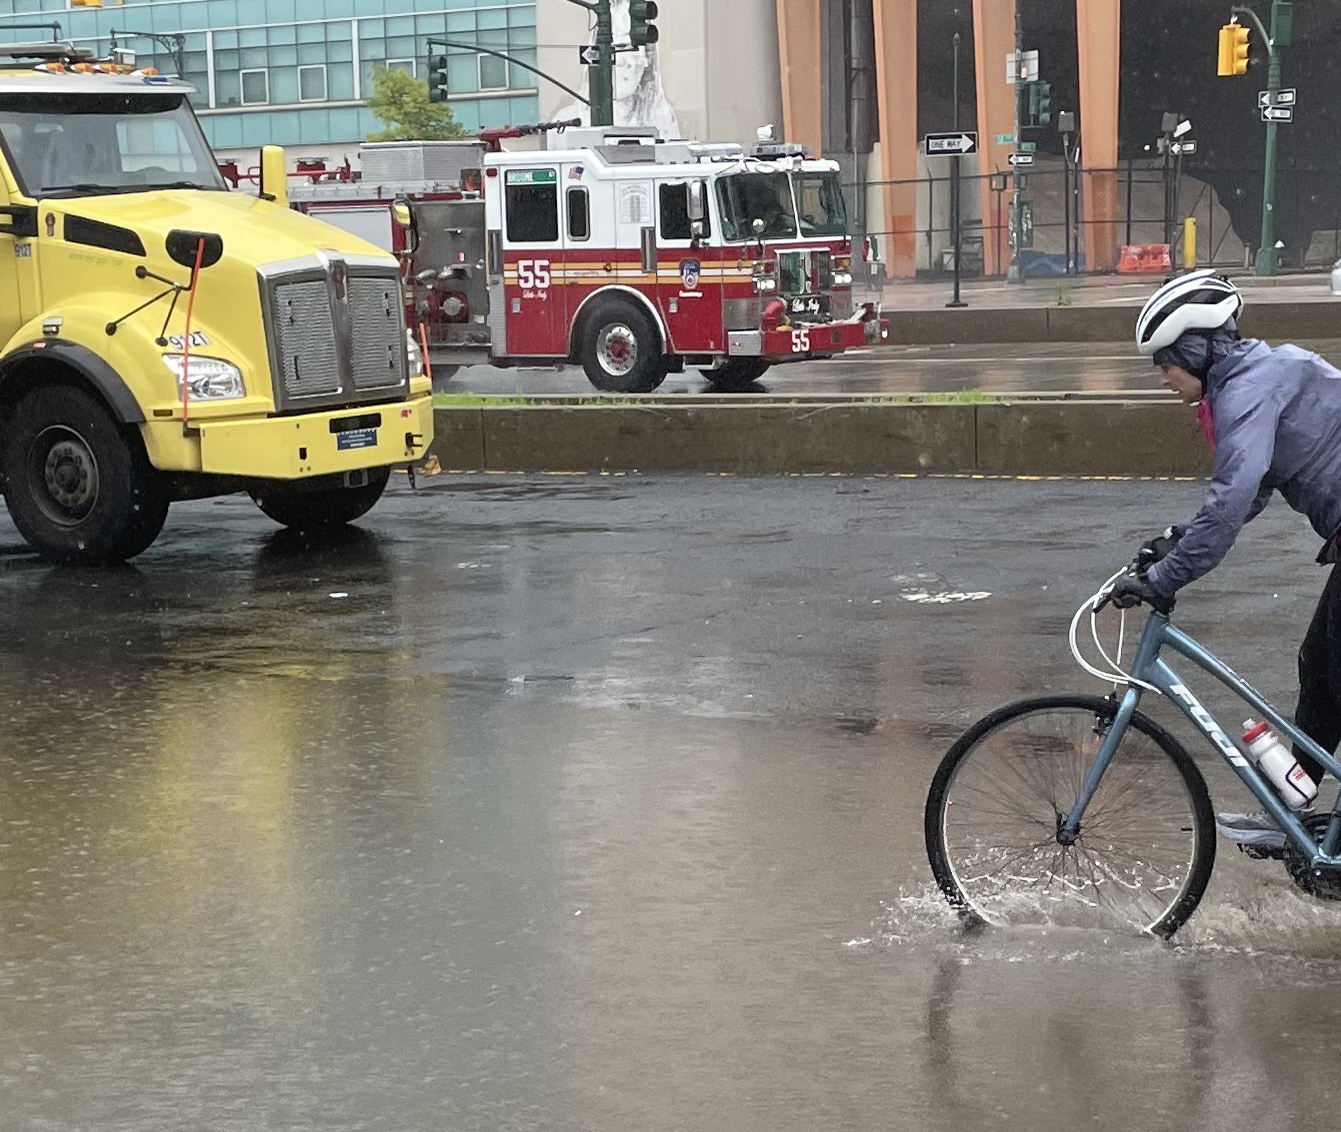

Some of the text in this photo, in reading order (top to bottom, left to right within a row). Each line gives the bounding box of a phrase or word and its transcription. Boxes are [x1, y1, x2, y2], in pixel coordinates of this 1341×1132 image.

[931, 139, 961, 149] ONE WAY
[517, 259, 551, 289] 55
[792, 329, 810, 353] 55
[1169, 683, 1250, 768] FUJI
